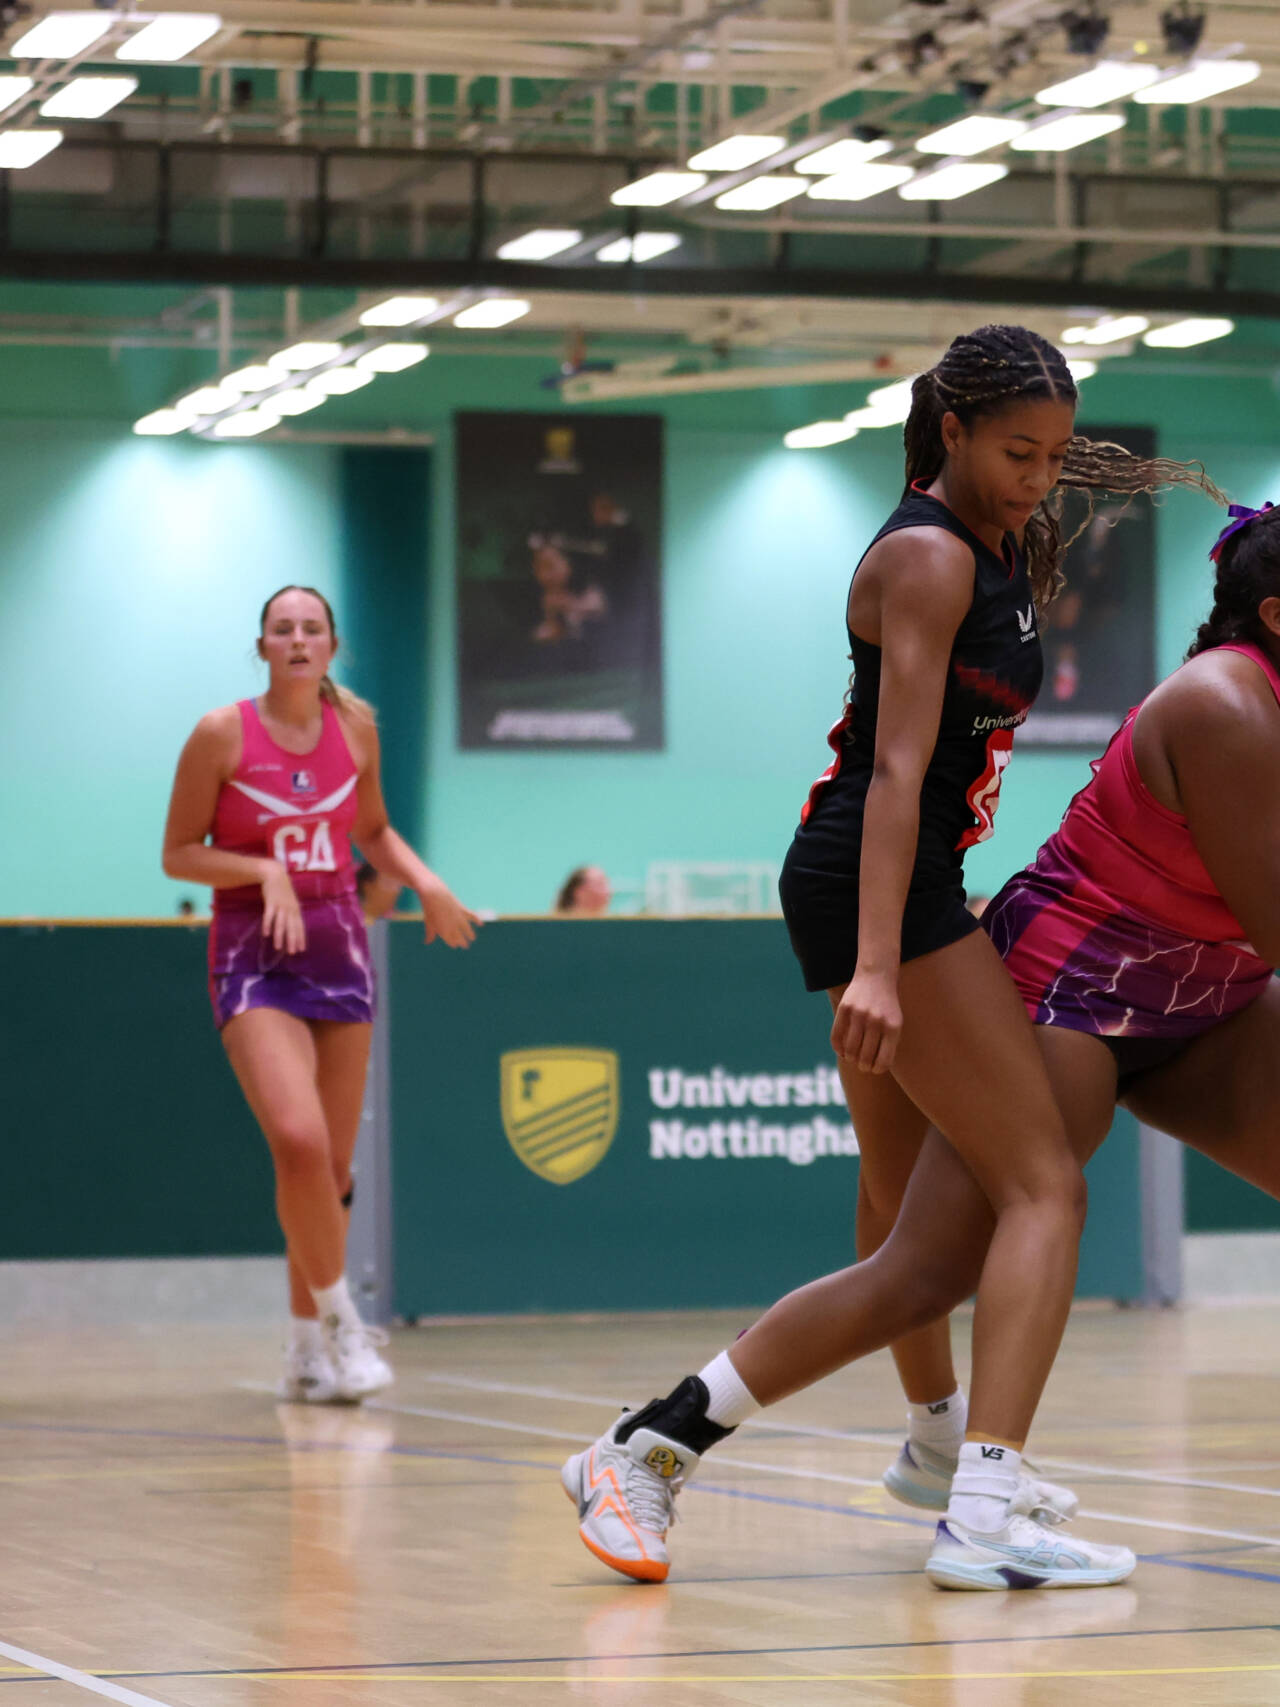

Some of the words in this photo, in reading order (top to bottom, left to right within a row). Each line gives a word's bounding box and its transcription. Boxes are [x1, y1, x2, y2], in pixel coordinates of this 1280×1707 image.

[273, 820, 335, 872] GA
[928, 1402, 949, 1415] VS
[981, 1446, 1005, 1461] VS
